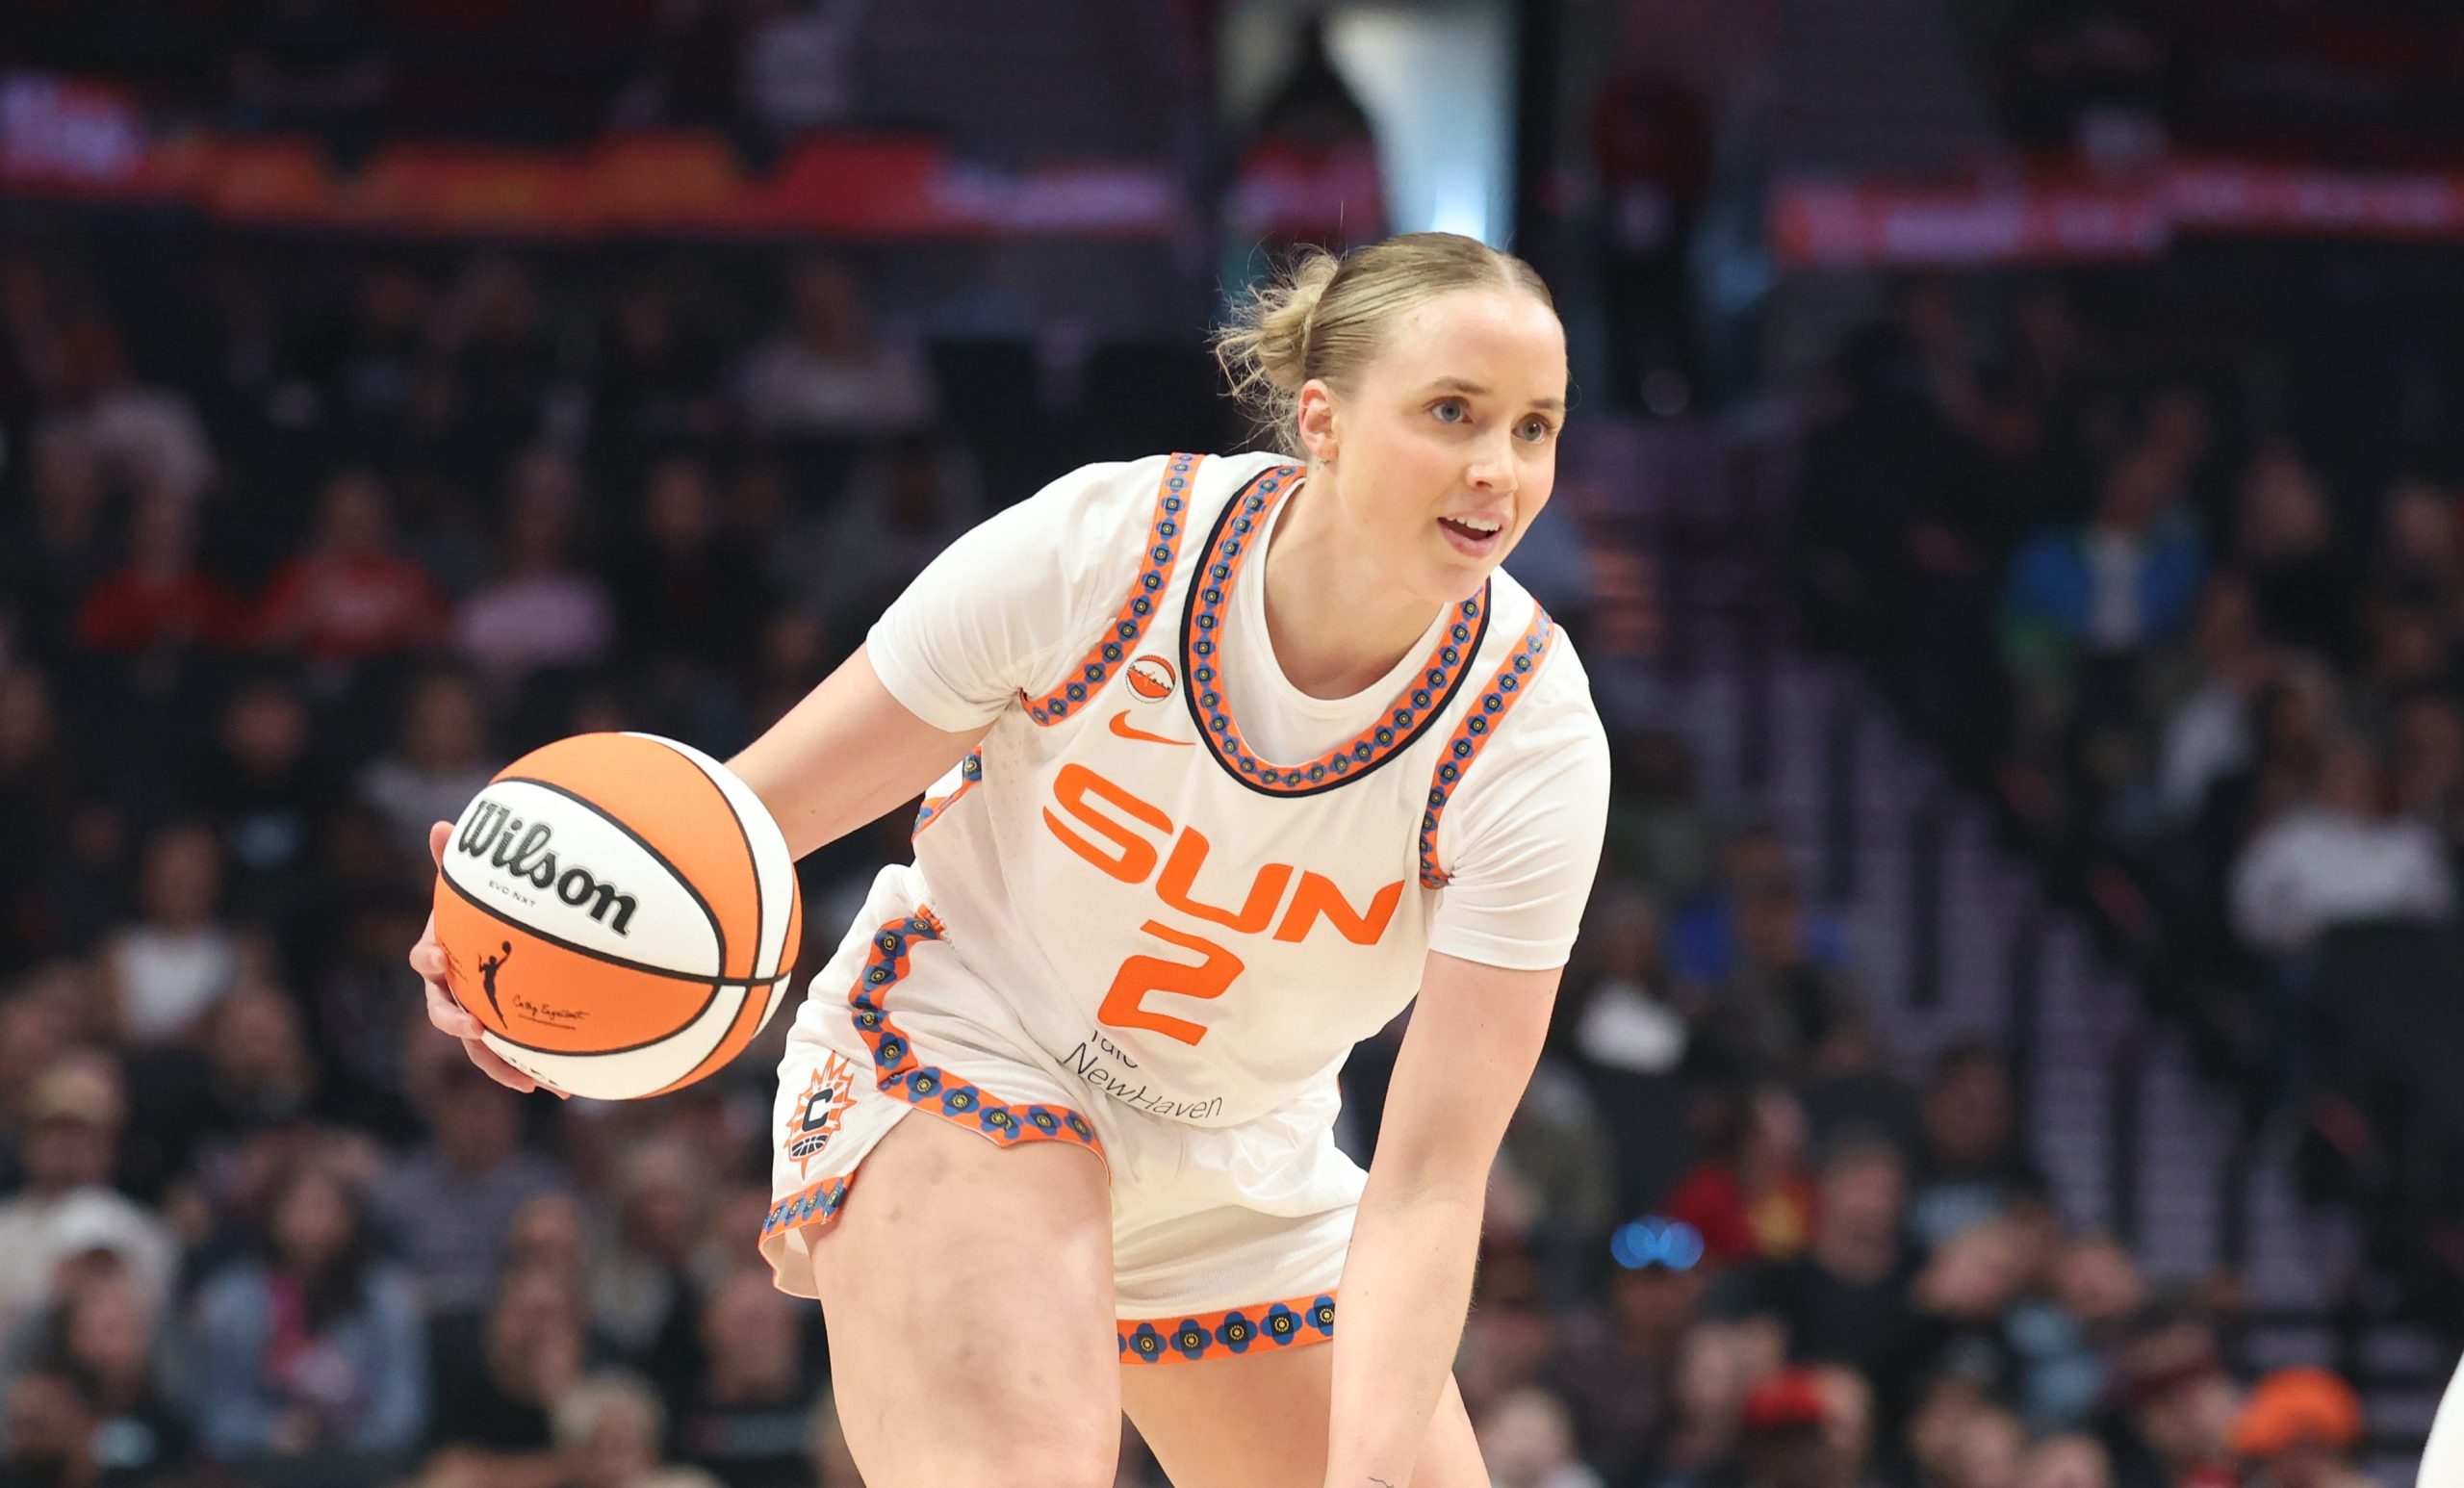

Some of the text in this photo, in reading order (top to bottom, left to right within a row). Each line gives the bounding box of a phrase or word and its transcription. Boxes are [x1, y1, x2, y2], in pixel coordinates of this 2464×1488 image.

[458, 800, 637, 936] Wilson
[512, 891, 537, 907] NXT
[1042, 763, 1405, 946] SUN
[1097, 919, 1245, 1047] 2
[802, 1088, 834, 1133] C
